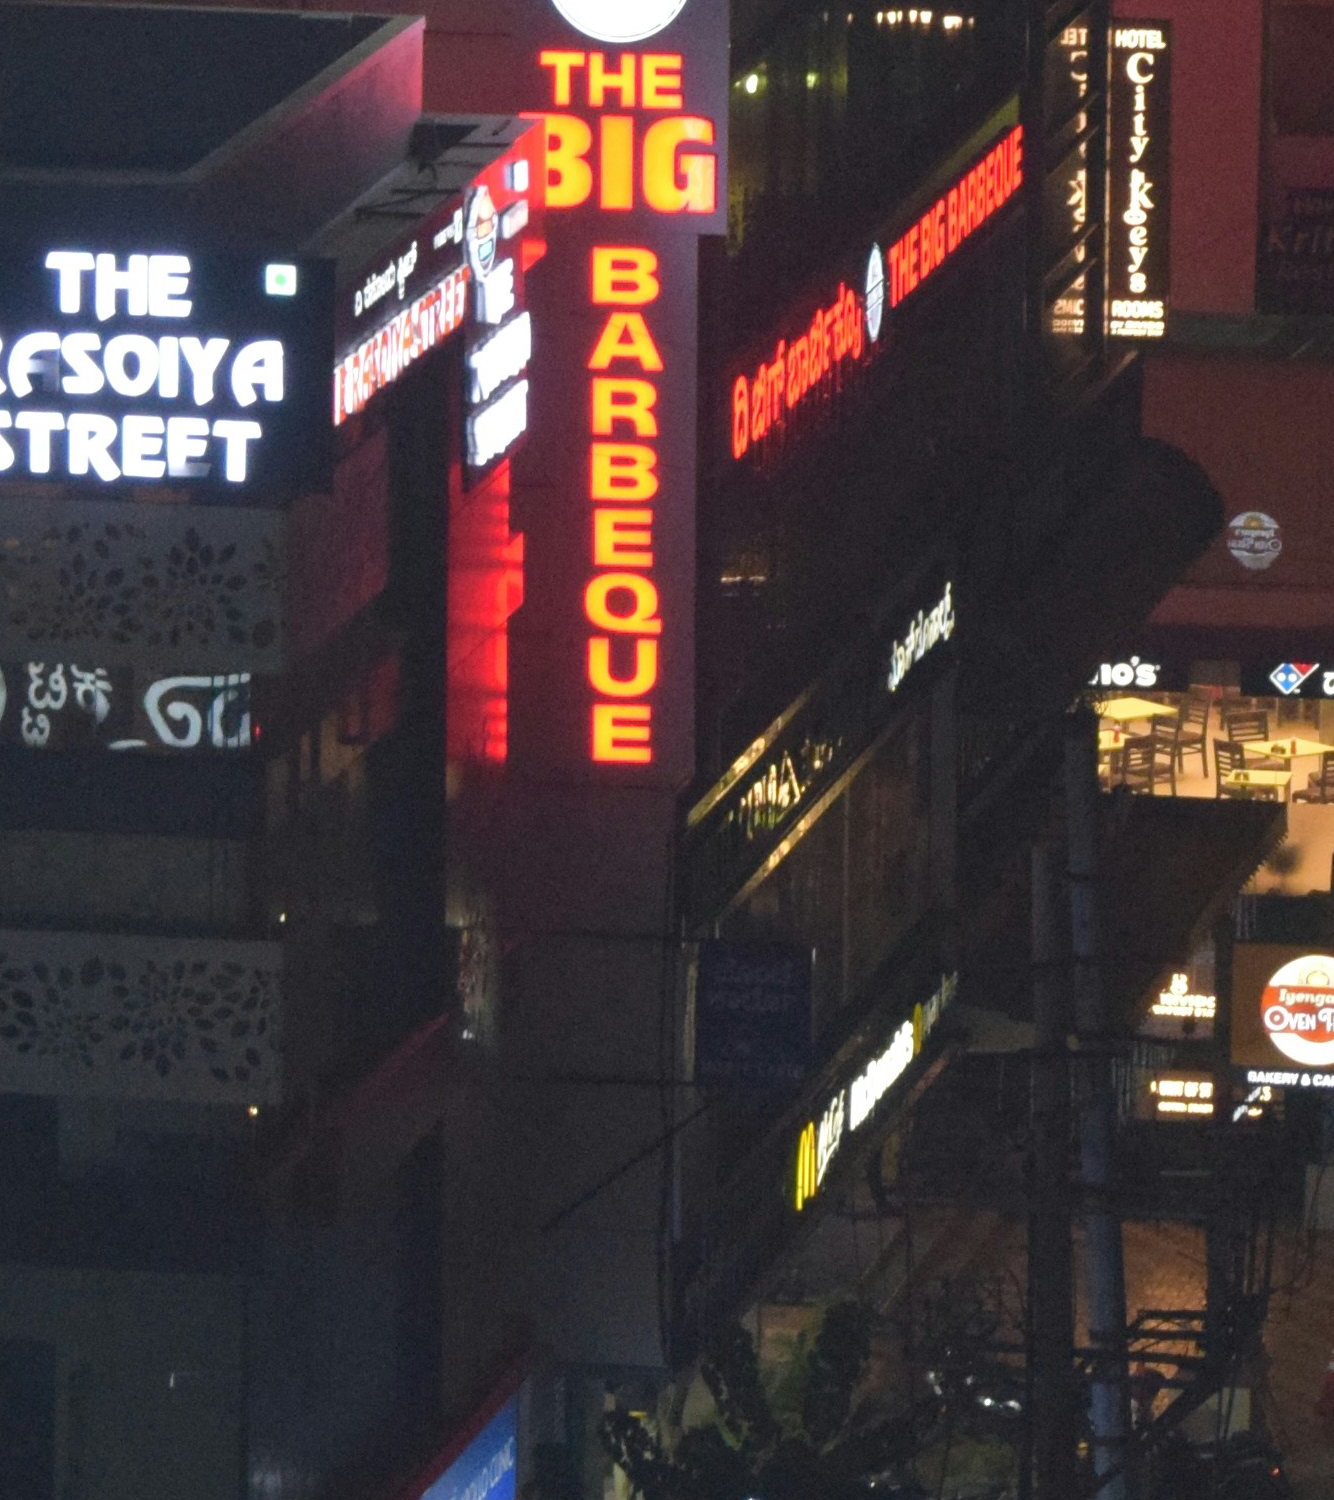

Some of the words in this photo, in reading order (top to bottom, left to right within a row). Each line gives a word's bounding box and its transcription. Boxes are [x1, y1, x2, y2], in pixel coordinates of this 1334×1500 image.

[1115, 29, 1166, 49] HOTEL
[540, 50, 682, 110] THE
[541, 114, 717, 214] BIG
[888, 223, 919, 308] THE
[919, 199, 947, 281] BIG
[947, 123, 1023, 254] BARBEQUE
[46, 251, 192, 321] THE
[584, 246, 662, 765] BARBEQUE
[1247, 1069, 1300, 1086] BAKERY
[1300, 1072, 1312, 1087] &
